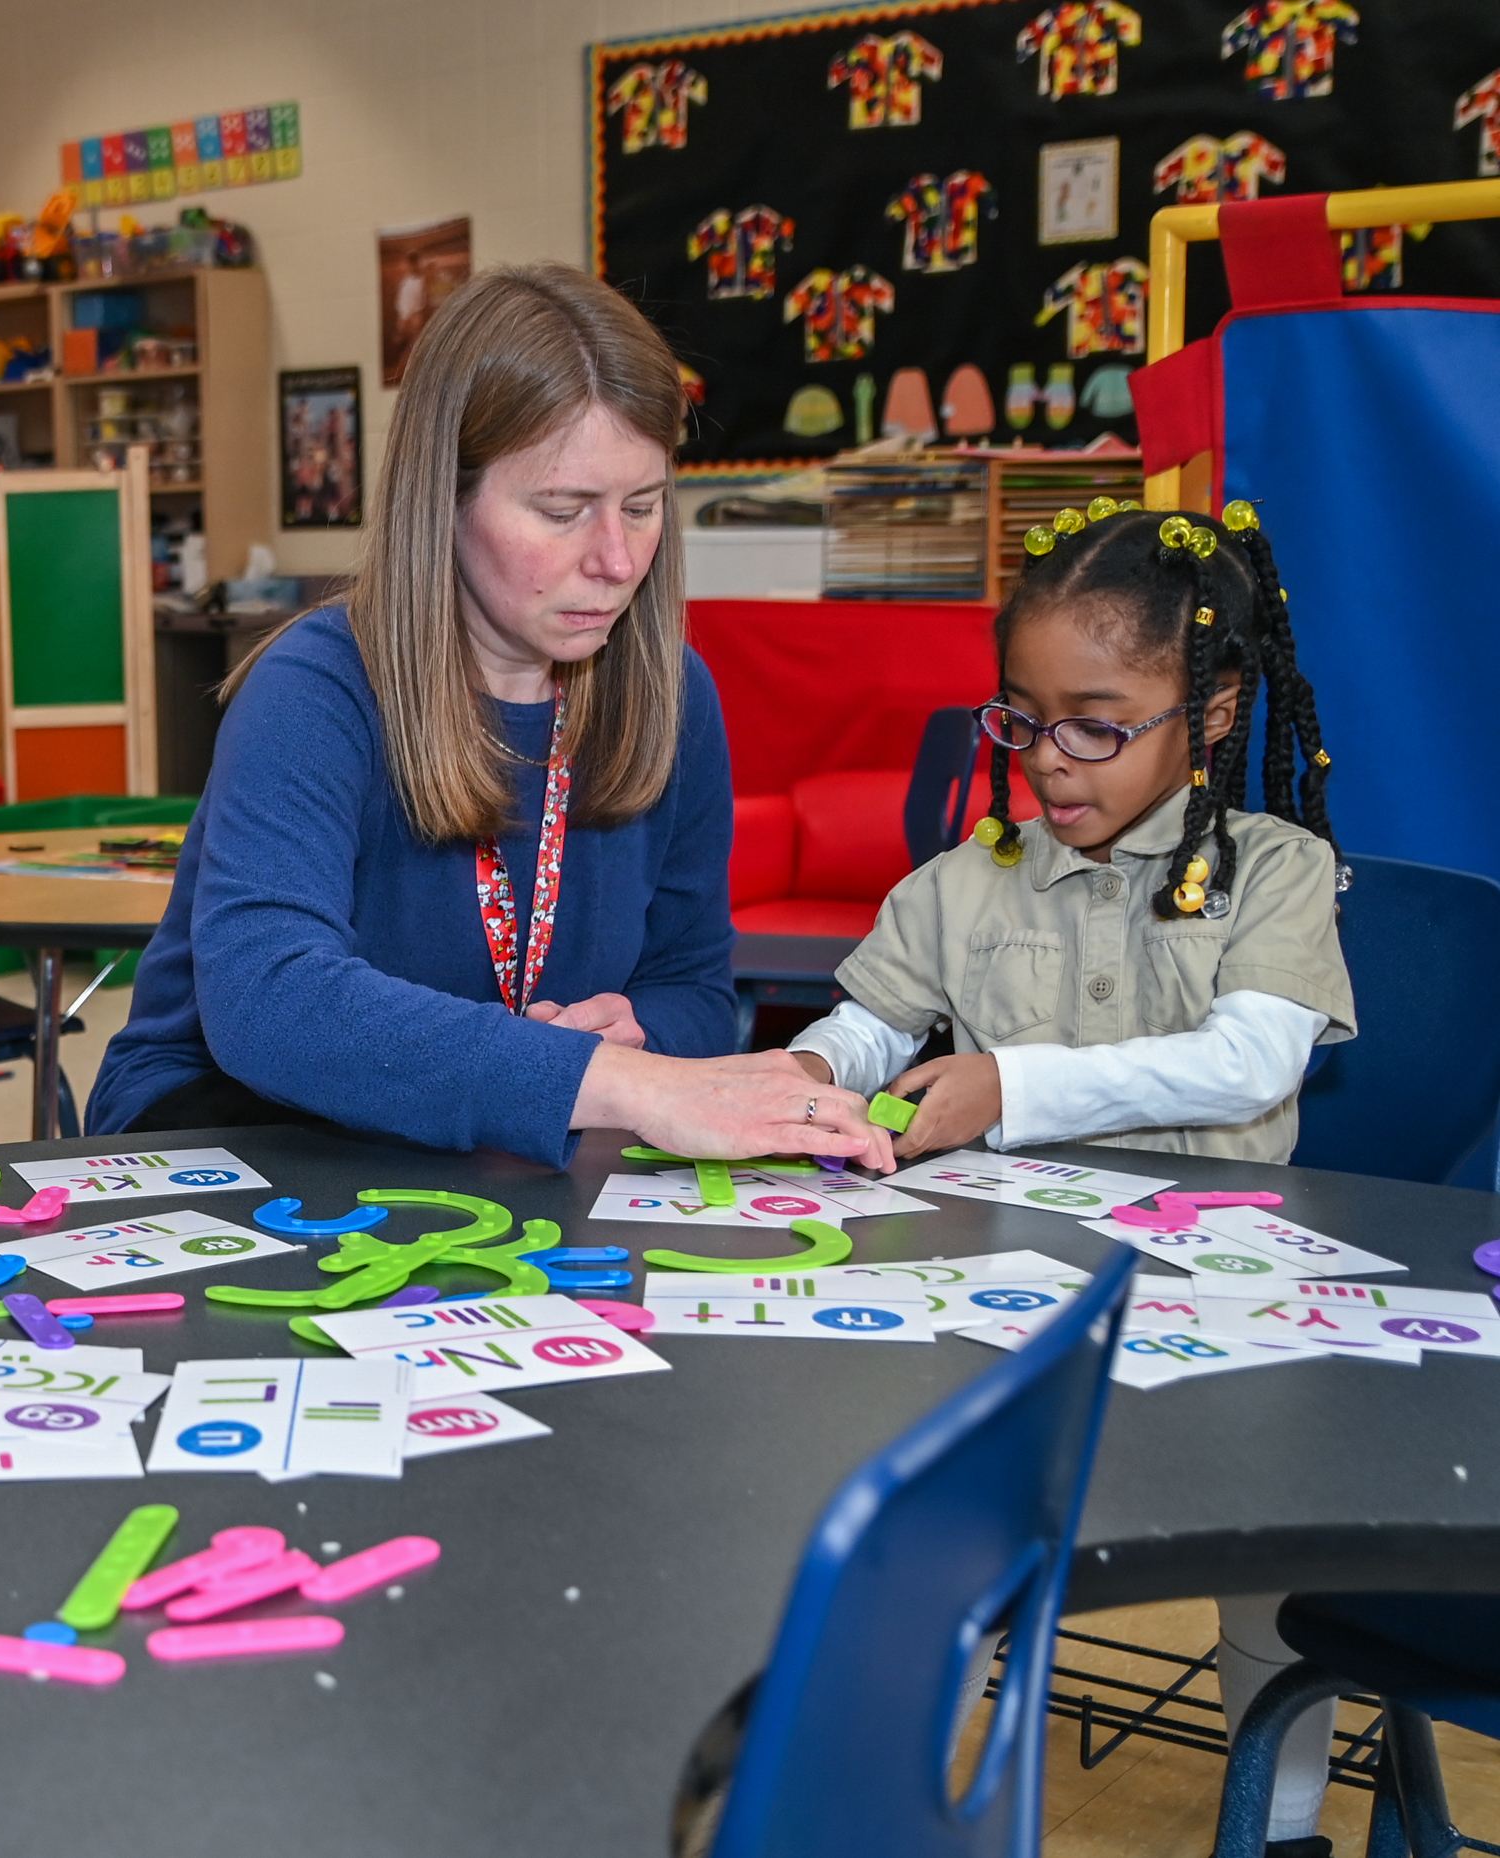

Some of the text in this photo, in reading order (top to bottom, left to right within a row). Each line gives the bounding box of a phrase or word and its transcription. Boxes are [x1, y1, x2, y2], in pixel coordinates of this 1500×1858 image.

[180, 1171, 229, 1184] Kk
[201, 1238, 235, 1253] Rr
[837, 1312, 880, 1327] Tt
[1403, 1321, 1461, 1343] Yy
[545, 1340, 611, 1361] Nn
[17, 1406, 84, 1428] Gg
